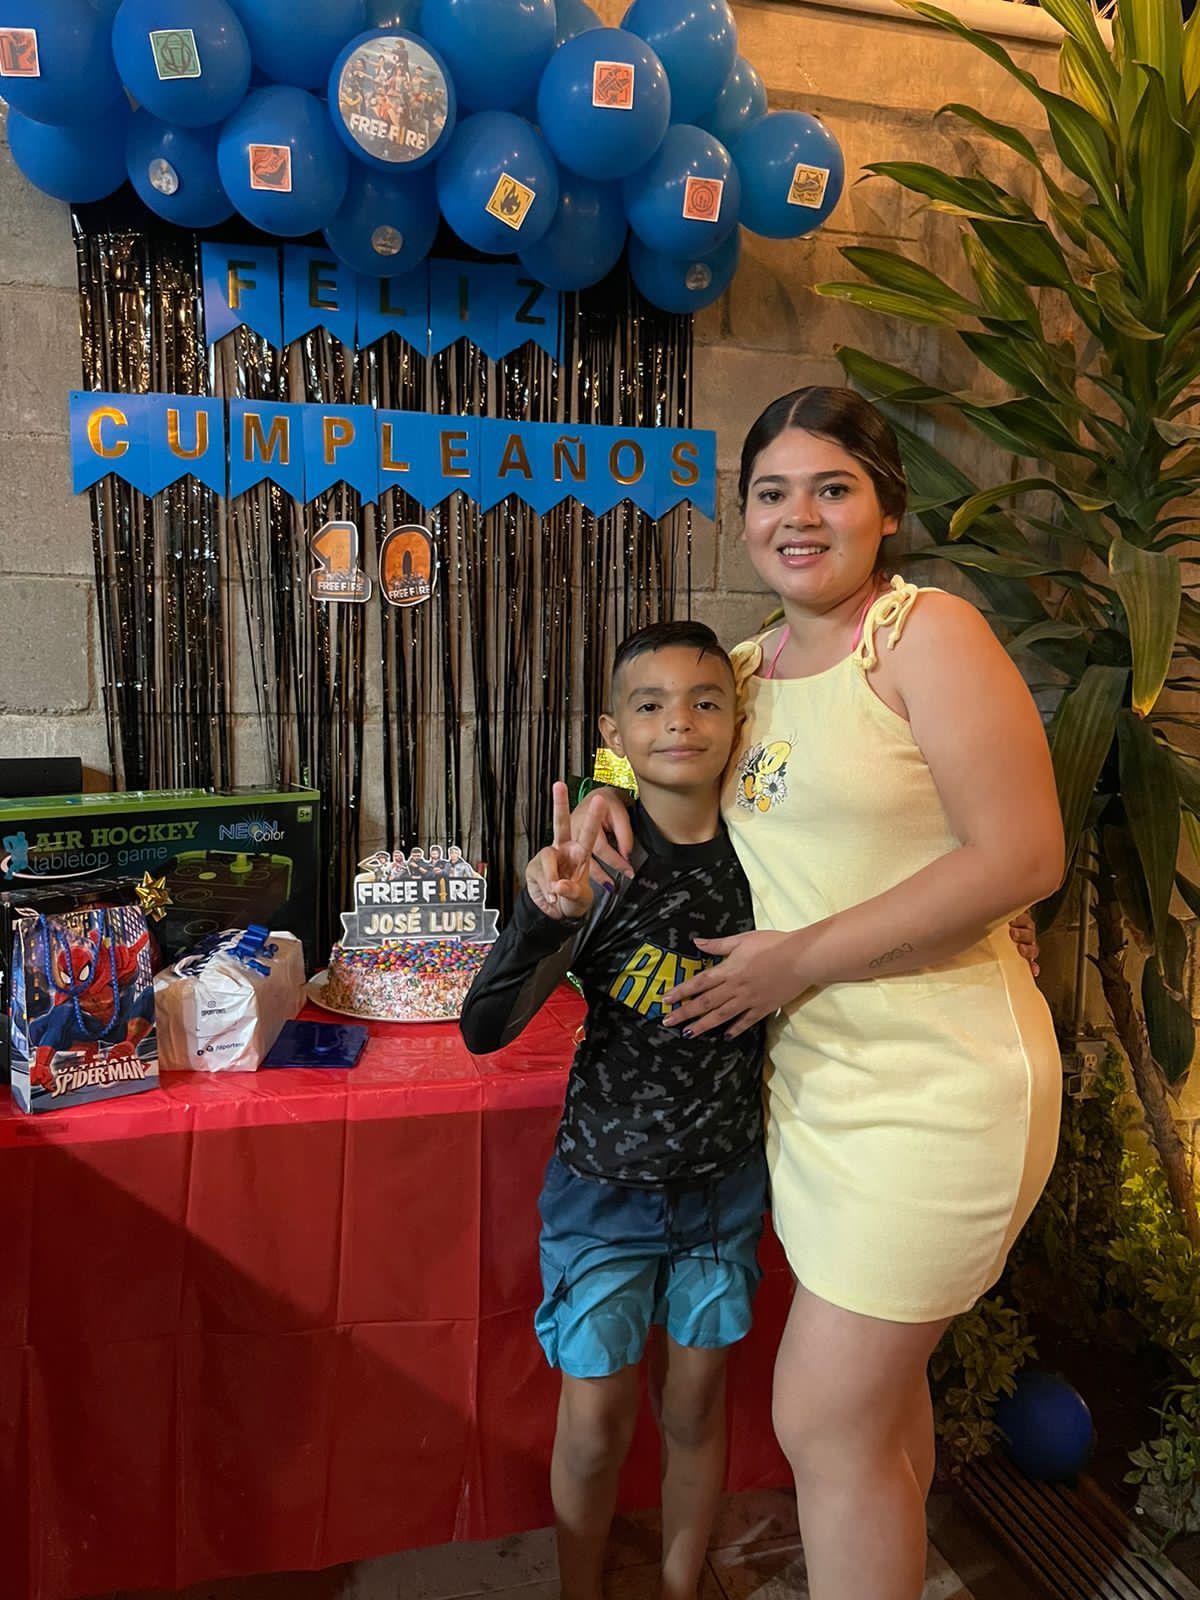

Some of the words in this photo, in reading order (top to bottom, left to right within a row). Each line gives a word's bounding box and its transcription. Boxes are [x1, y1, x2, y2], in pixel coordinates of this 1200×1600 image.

[350, 113, 388, 138] FREE
[390, 126, 426, 149] FIRE
[227, 259, 546, 325] FELIZ
[87, 406, 699, 486] CUMPLEAÑOS
[318, 582, 340, 592] FREE
[388, 587, 409, 600] FREE
[410, 584, 431, 597] FIRE
[299, 809, 310, 818] 5+
[34, 830, 84, 852] AIR
[91, 821, 200, 848] HOCKEY
[219, 820, 279, 841] NEON
[253, 829, 286, 842] Color
[33, 849, 110, 873] tabletop
[117, 846, 168, 867] game
[359, 880, 418, 905] FREE
[421, 877, 480, 904] FIRE
[363, 906, 422, 935] JOSÉ
[429, 911, 477, 932] LUIS
[51, 1059, 146, 1098] SPIDER-MAN
